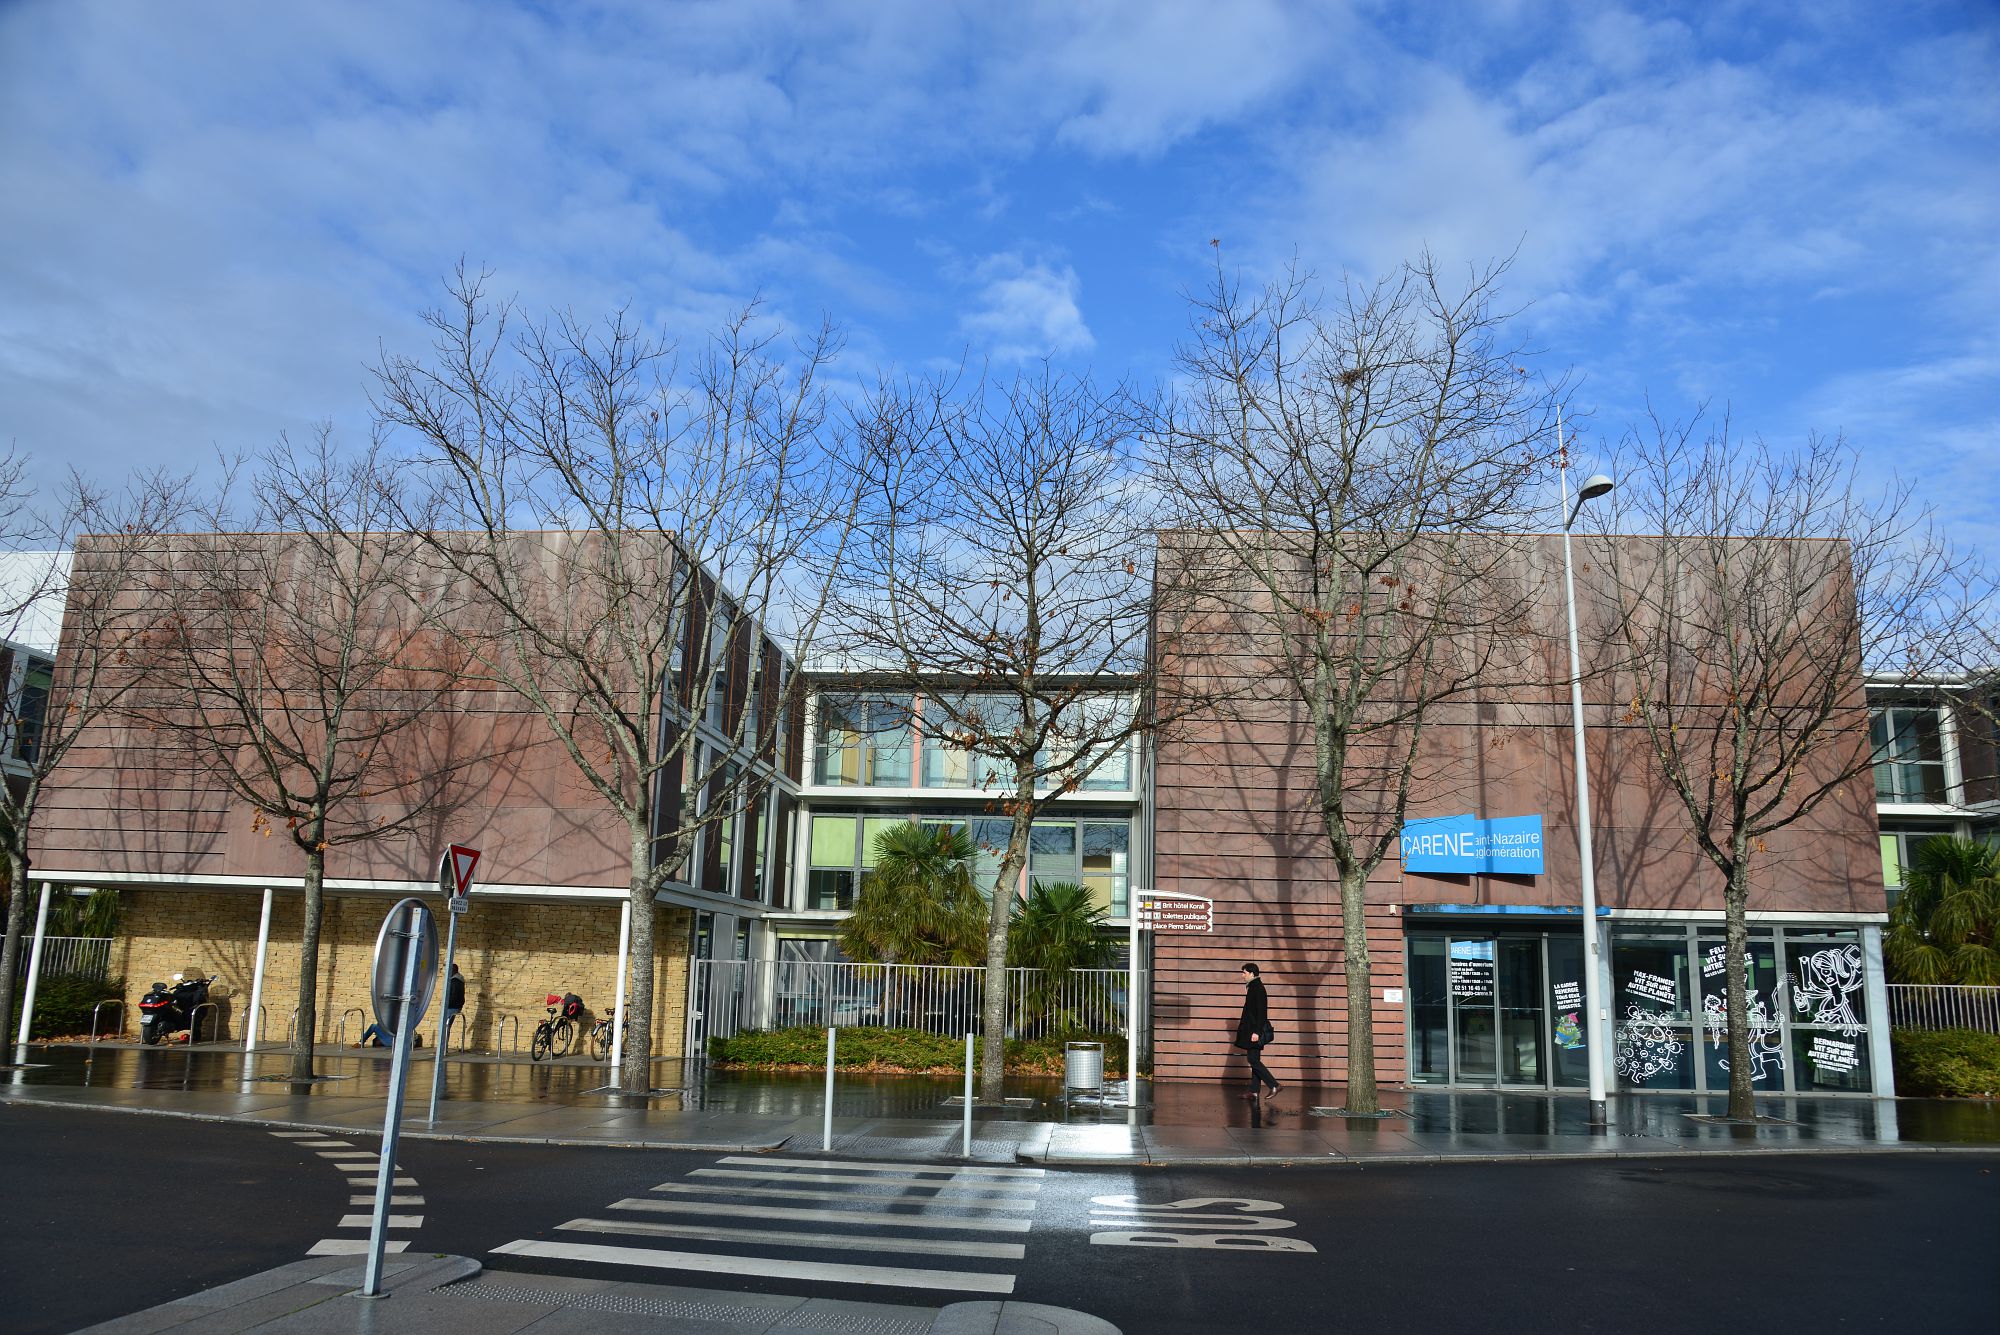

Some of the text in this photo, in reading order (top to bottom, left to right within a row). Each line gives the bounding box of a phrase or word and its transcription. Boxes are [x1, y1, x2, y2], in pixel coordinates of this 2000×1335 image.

[1402, 831, 1540, 857] CARENE aint-Nazaire
[1705, 953, 1726, 964] VIT SU
[1703, 961, 1724, 973] AUTRE
[1633, 970, 1675, 987] MAX-FRANCIS
[1634, 977, 1672, 993] VIT SUR UNE
[1627, 981, 1648, 993] AUTRE
[1813, 1036, 1856, 1051] BERNARDINE
[1807, 1050, 1830, 1060] AUTRE
[1814, 1044, 1855, 1058] VIT SUR UNE
[1089, 1194, 1318, 1253] BUS
